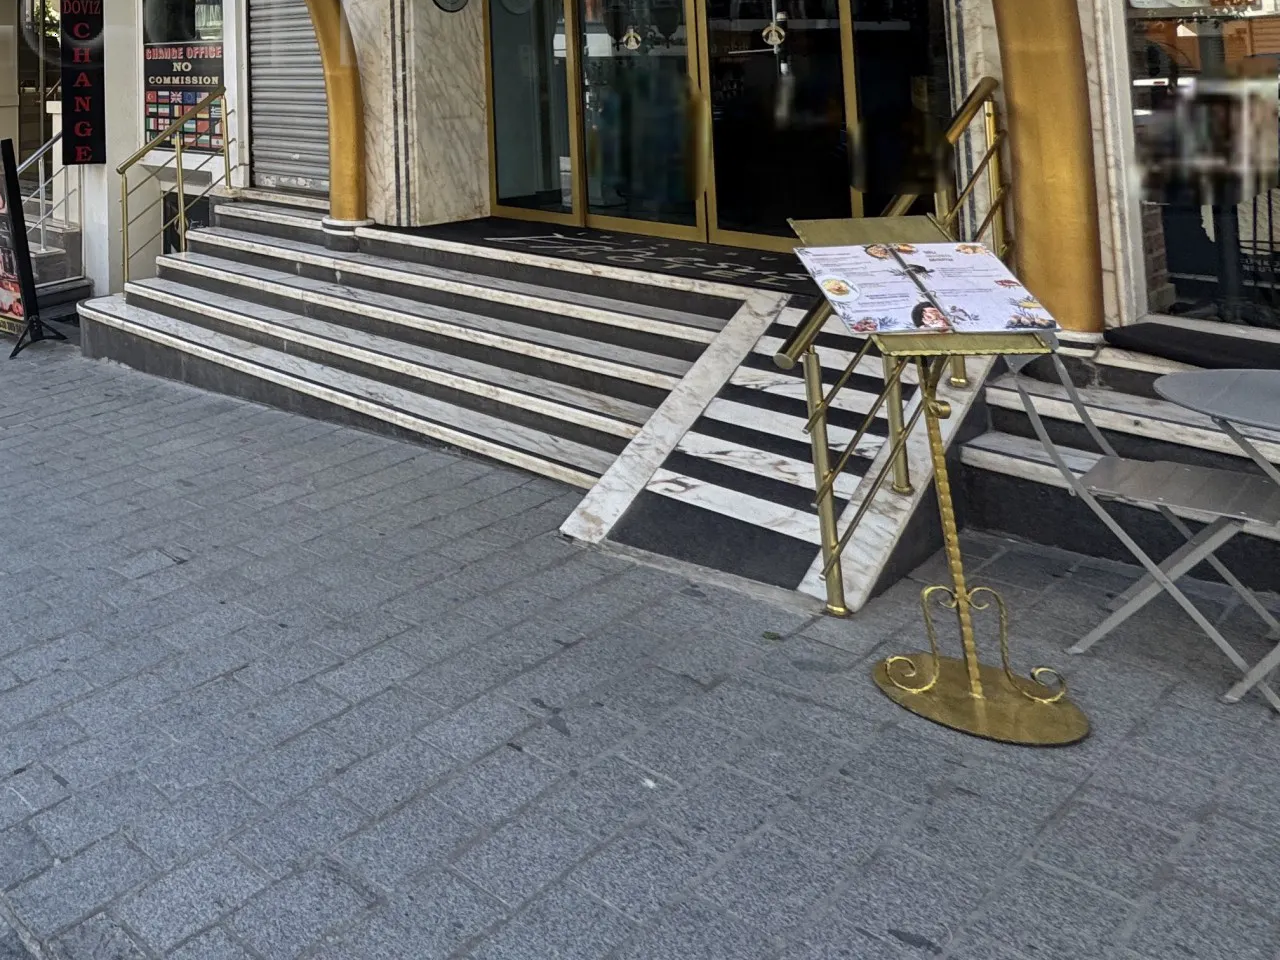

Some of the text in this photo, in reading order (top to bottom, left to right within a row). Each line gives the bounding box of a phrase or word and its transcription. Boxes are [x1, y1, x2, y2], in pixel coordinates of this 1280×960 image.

[186, 46, 222, 59] OFFICE
[172, 62, 192, 71] NO
[148, 76, 219, 84] COMMISSION
[72, 22, 93, 162] CHANGE
